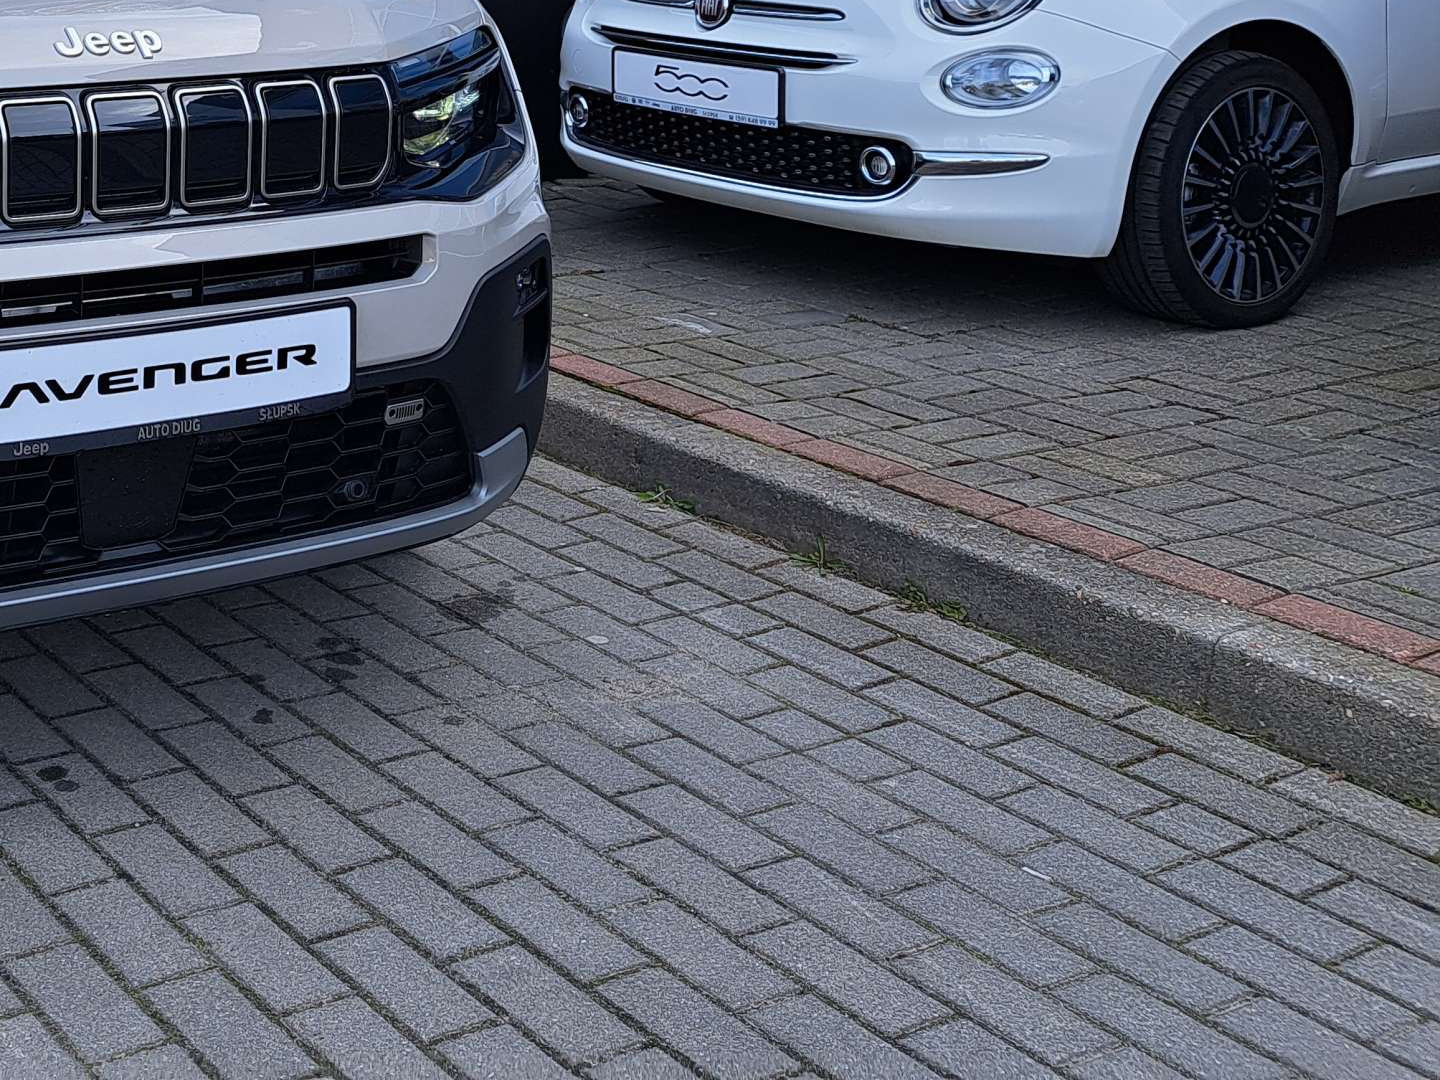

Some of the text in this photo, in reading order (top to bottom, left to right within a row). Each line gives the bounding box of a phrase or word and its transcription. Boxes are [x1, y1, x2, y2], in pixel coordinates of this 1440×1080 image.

[53, 27, 163, 59] Jeep
[654, 64, 729, 101] 500
[0, 343, 318, 409] AVENGER
[13, 440, 50, 457] Jeep
[137, 422, 170, 441] AUTO
[171, 418, 201, 436] DIUG
